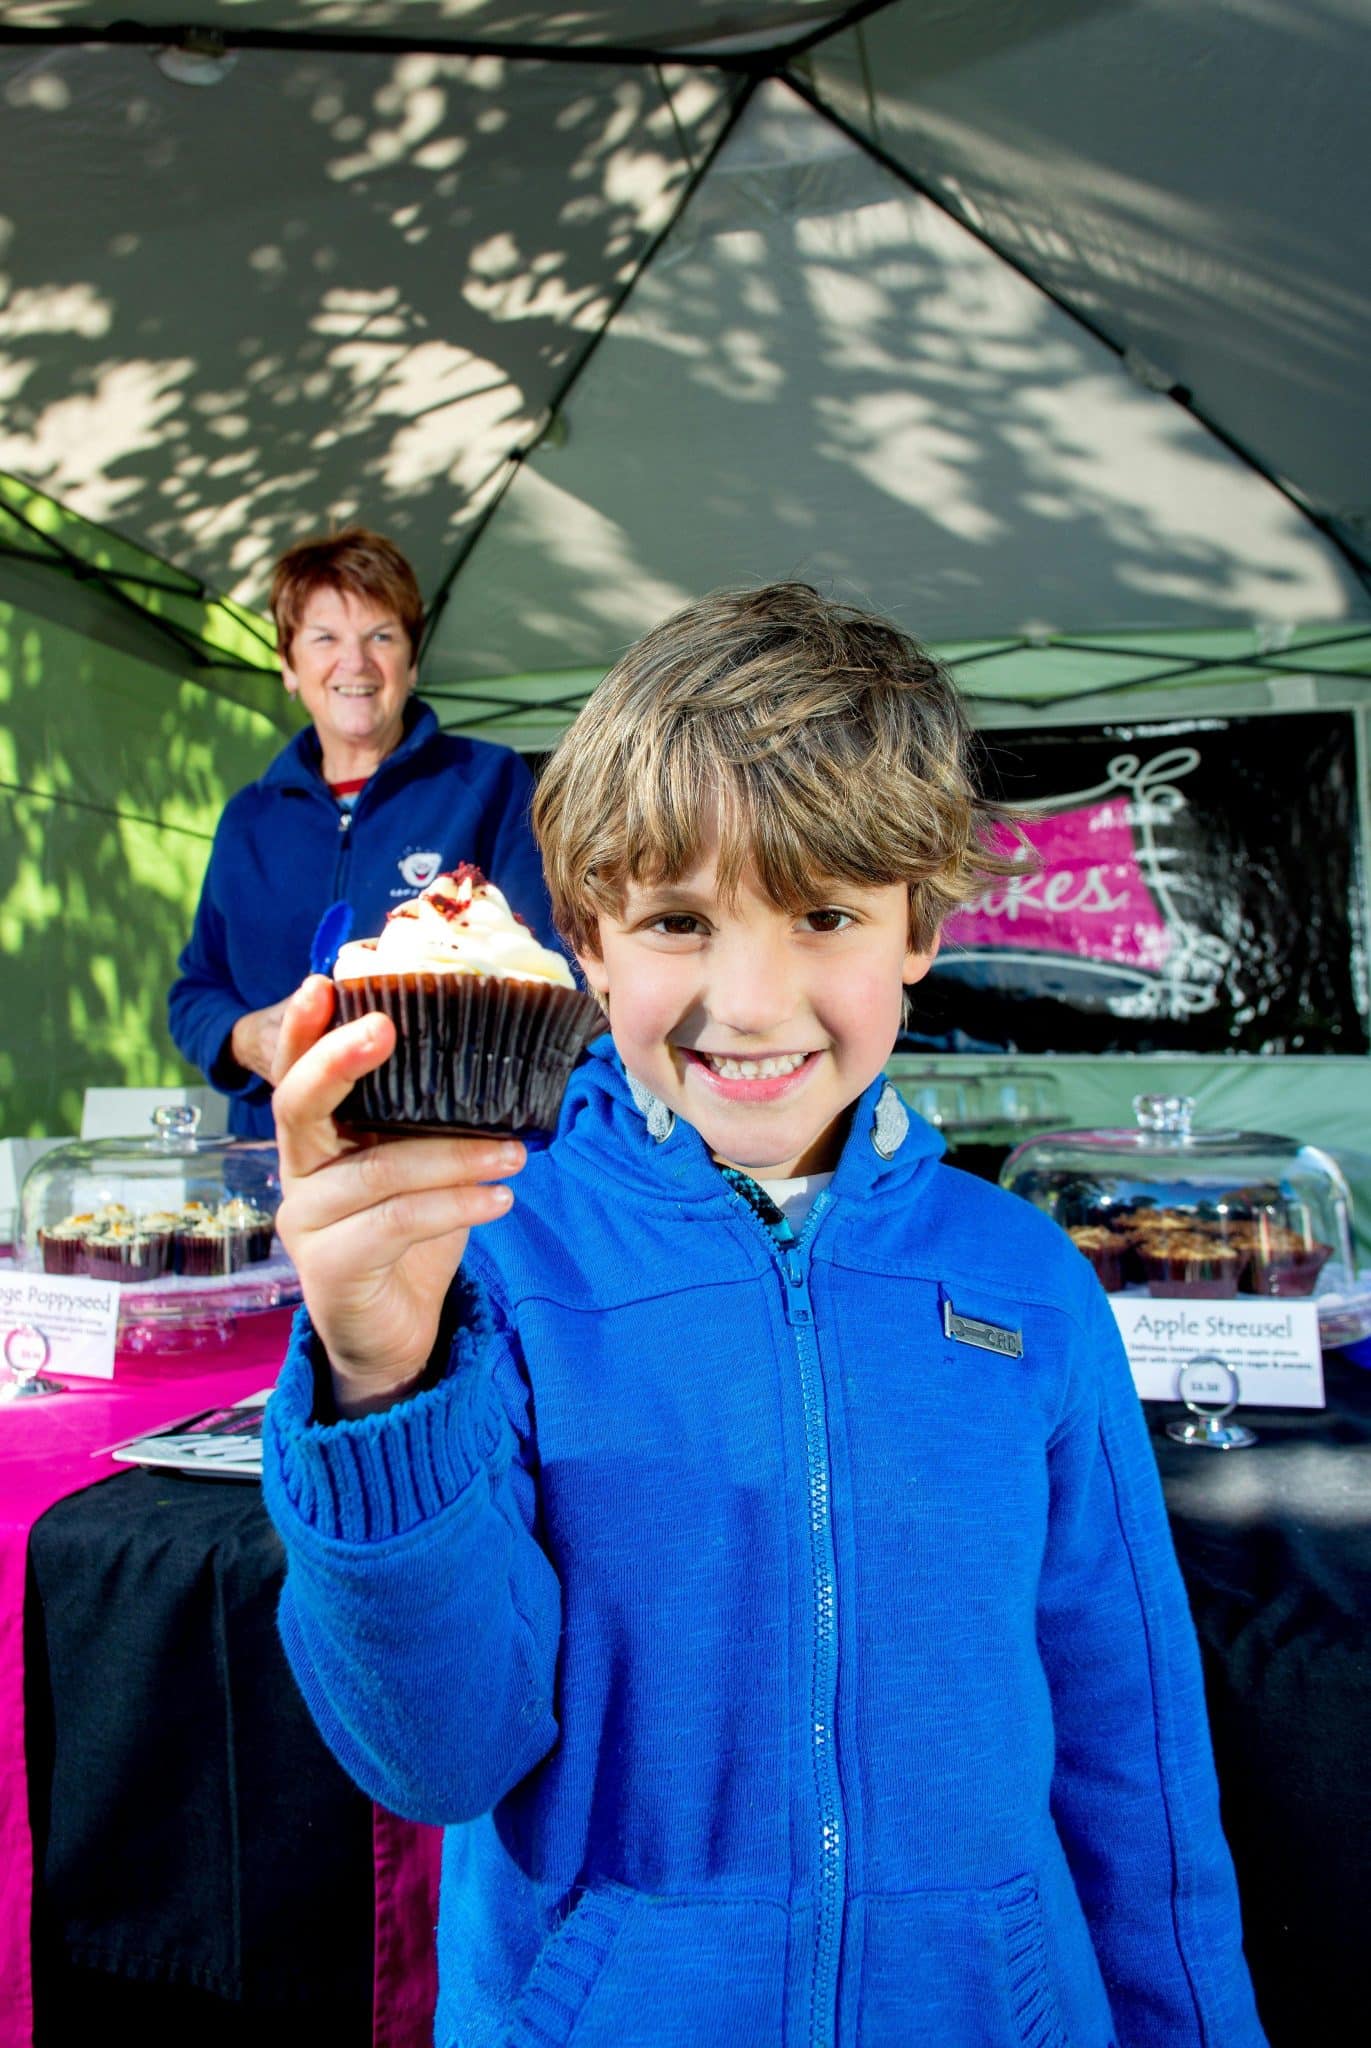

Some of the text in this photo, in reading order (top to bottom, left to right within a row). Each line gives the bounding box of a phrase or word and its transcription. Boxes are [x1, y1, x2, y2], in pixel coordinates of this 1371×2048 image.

[960, 846, 1130, 921] akes
[28, 1285, 111, 1312] Poppyseed
[1133, 1312, 1293, 1341] Apple Streusel
